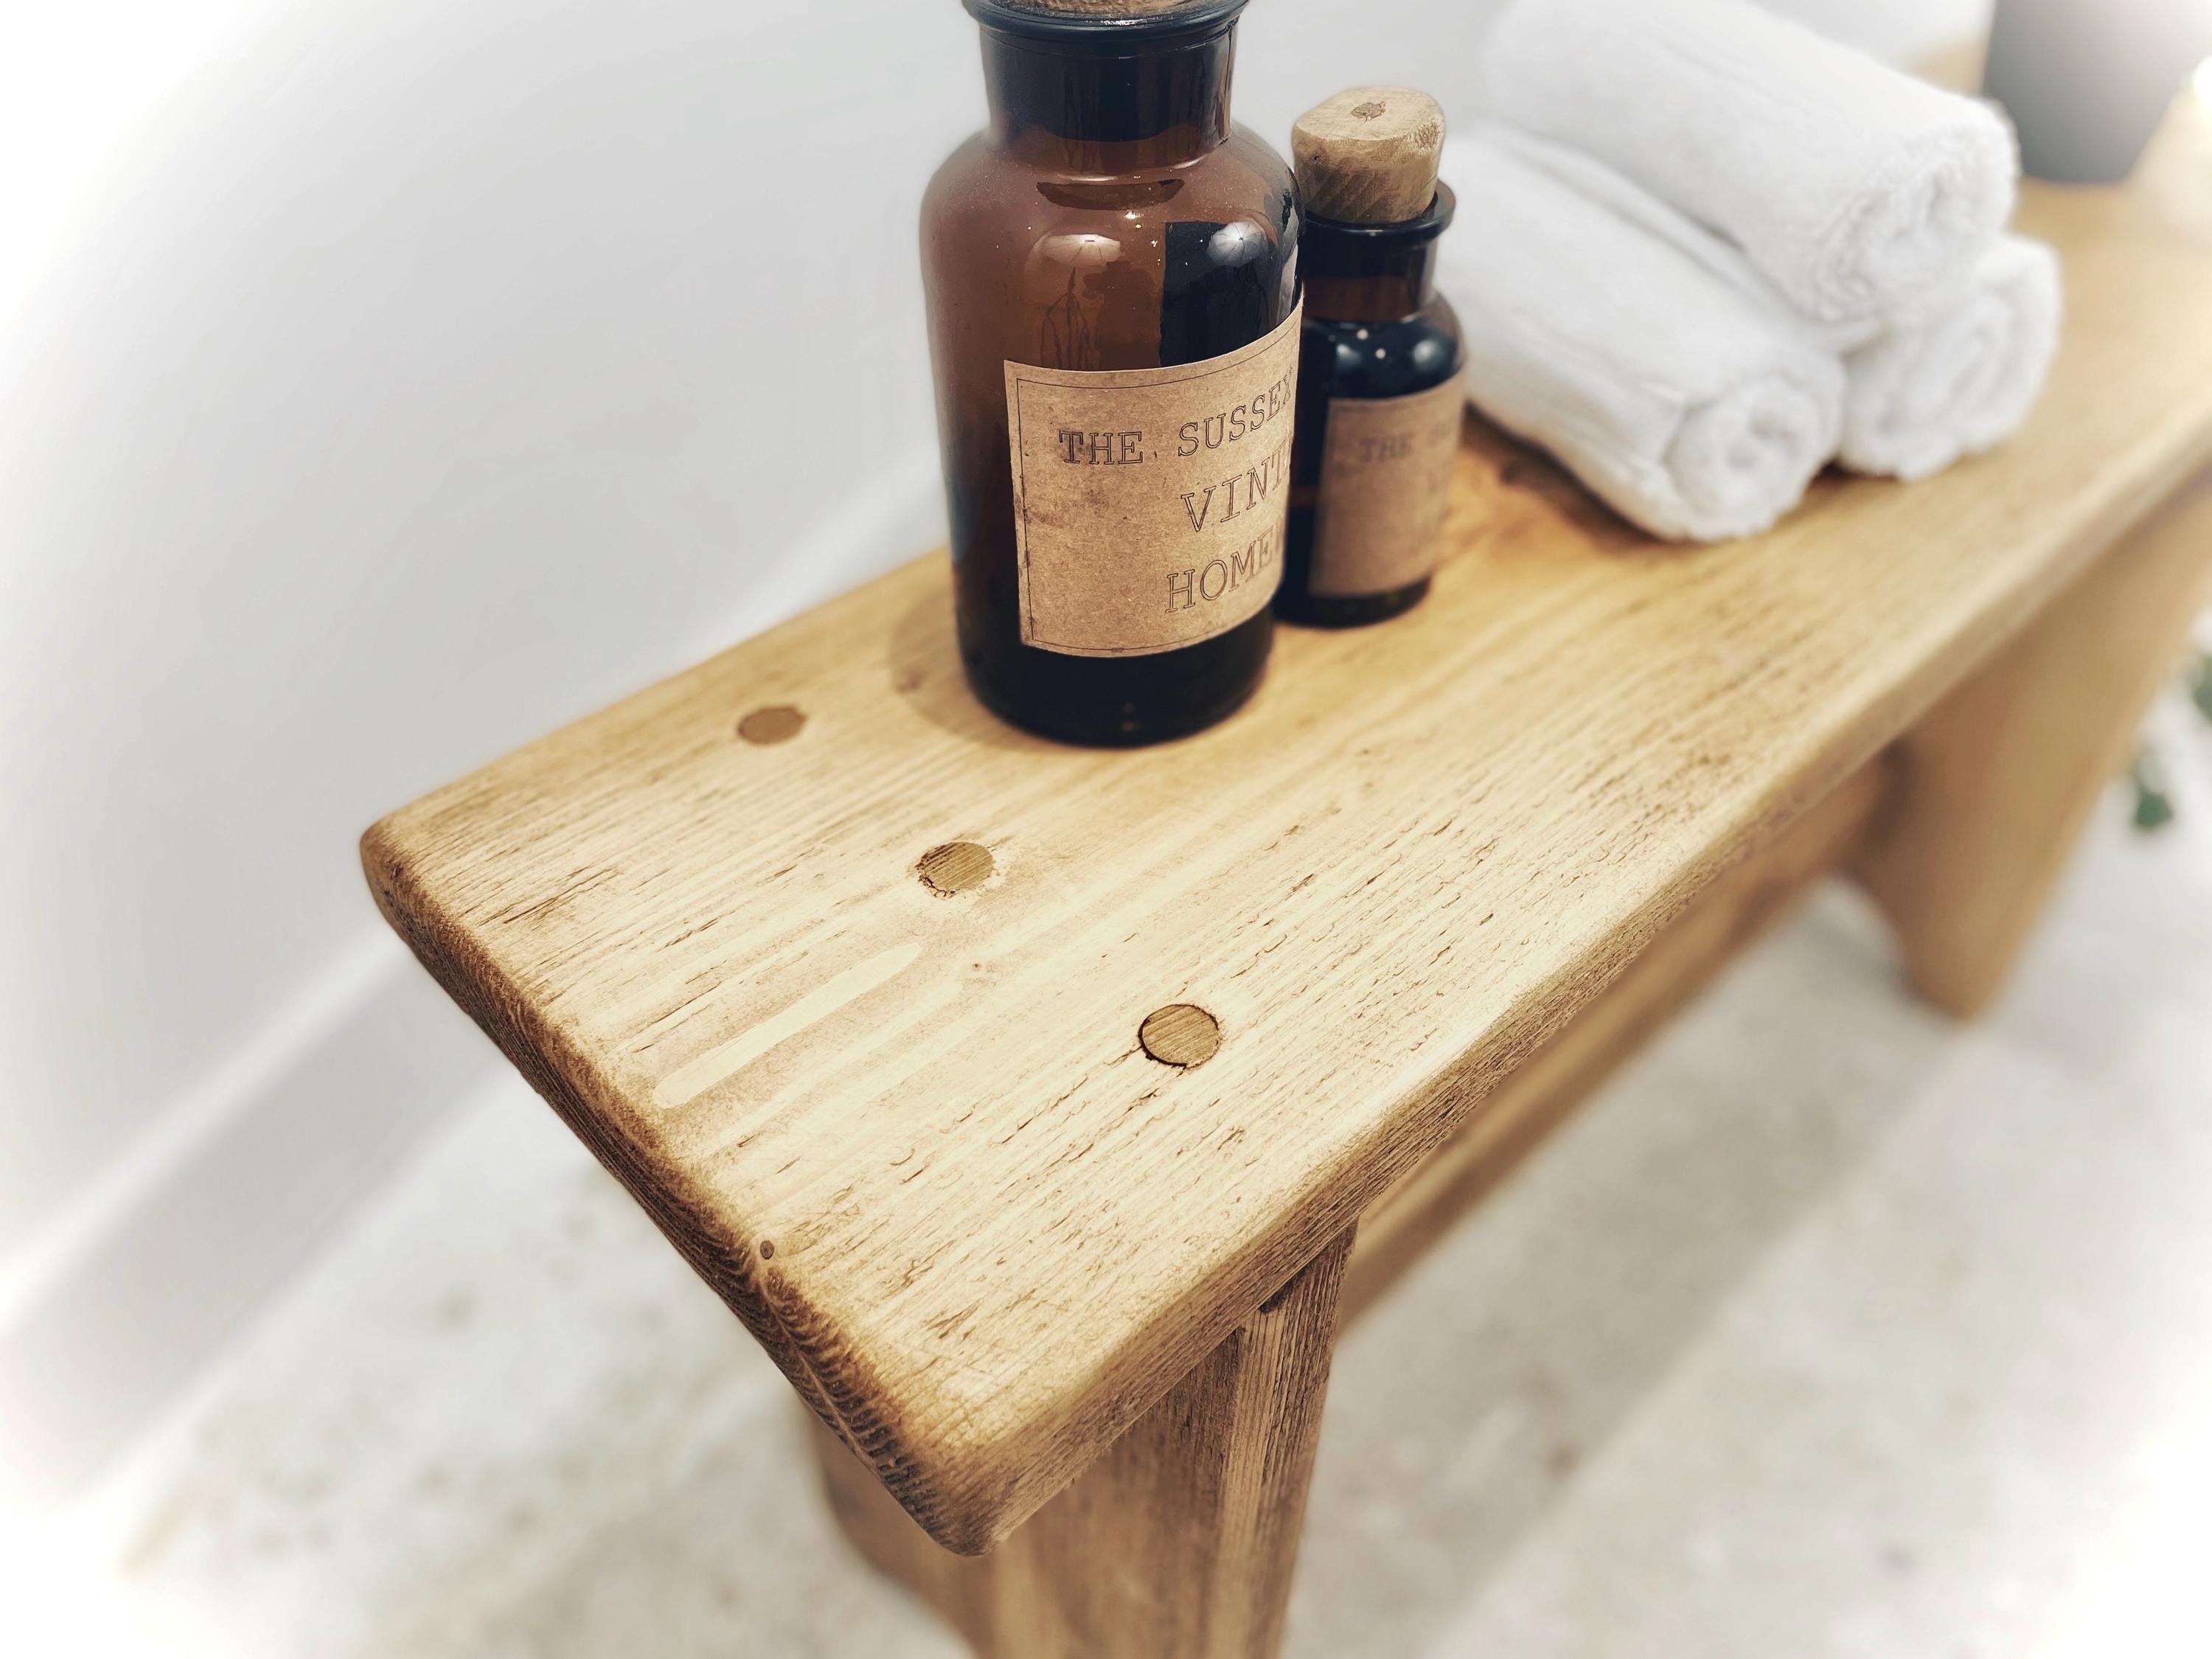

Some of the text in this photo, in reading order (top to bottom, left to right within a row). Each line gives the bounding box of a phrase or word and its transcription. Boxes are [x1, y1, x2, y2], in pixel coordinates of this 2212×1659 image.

[1058, 366, 1293, 465] THE SUSSEX
[1181, 434, 1291, 532] VINT
[1165, 519, 1283, 614] HOME
